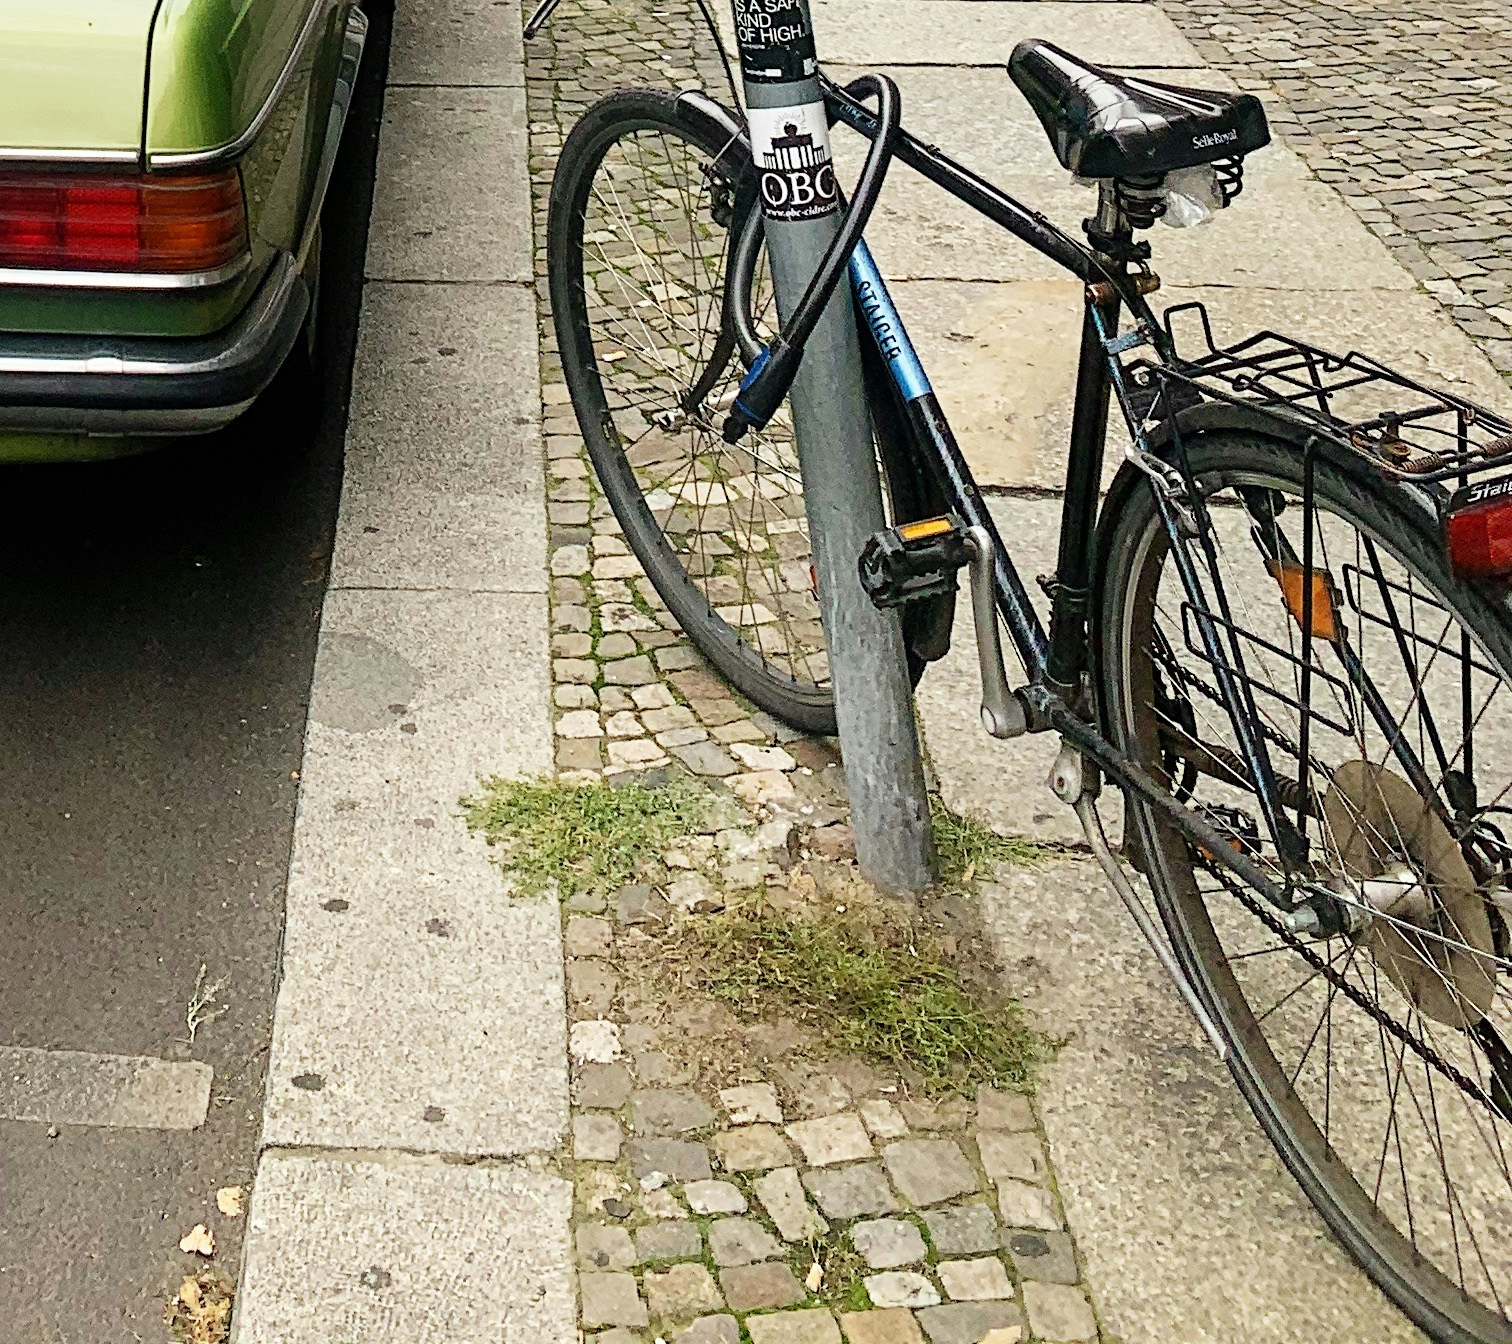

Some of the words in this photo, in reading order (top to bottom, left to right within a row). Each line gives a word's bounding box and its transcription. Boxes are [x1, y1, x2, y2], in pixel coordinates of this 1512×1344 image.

[736, 11, 772, 28] KIND
[738, 26, 756, 43] OF
[760, 23, 806, 43] HIGH.
[761, 163, 836, 208] OBC
